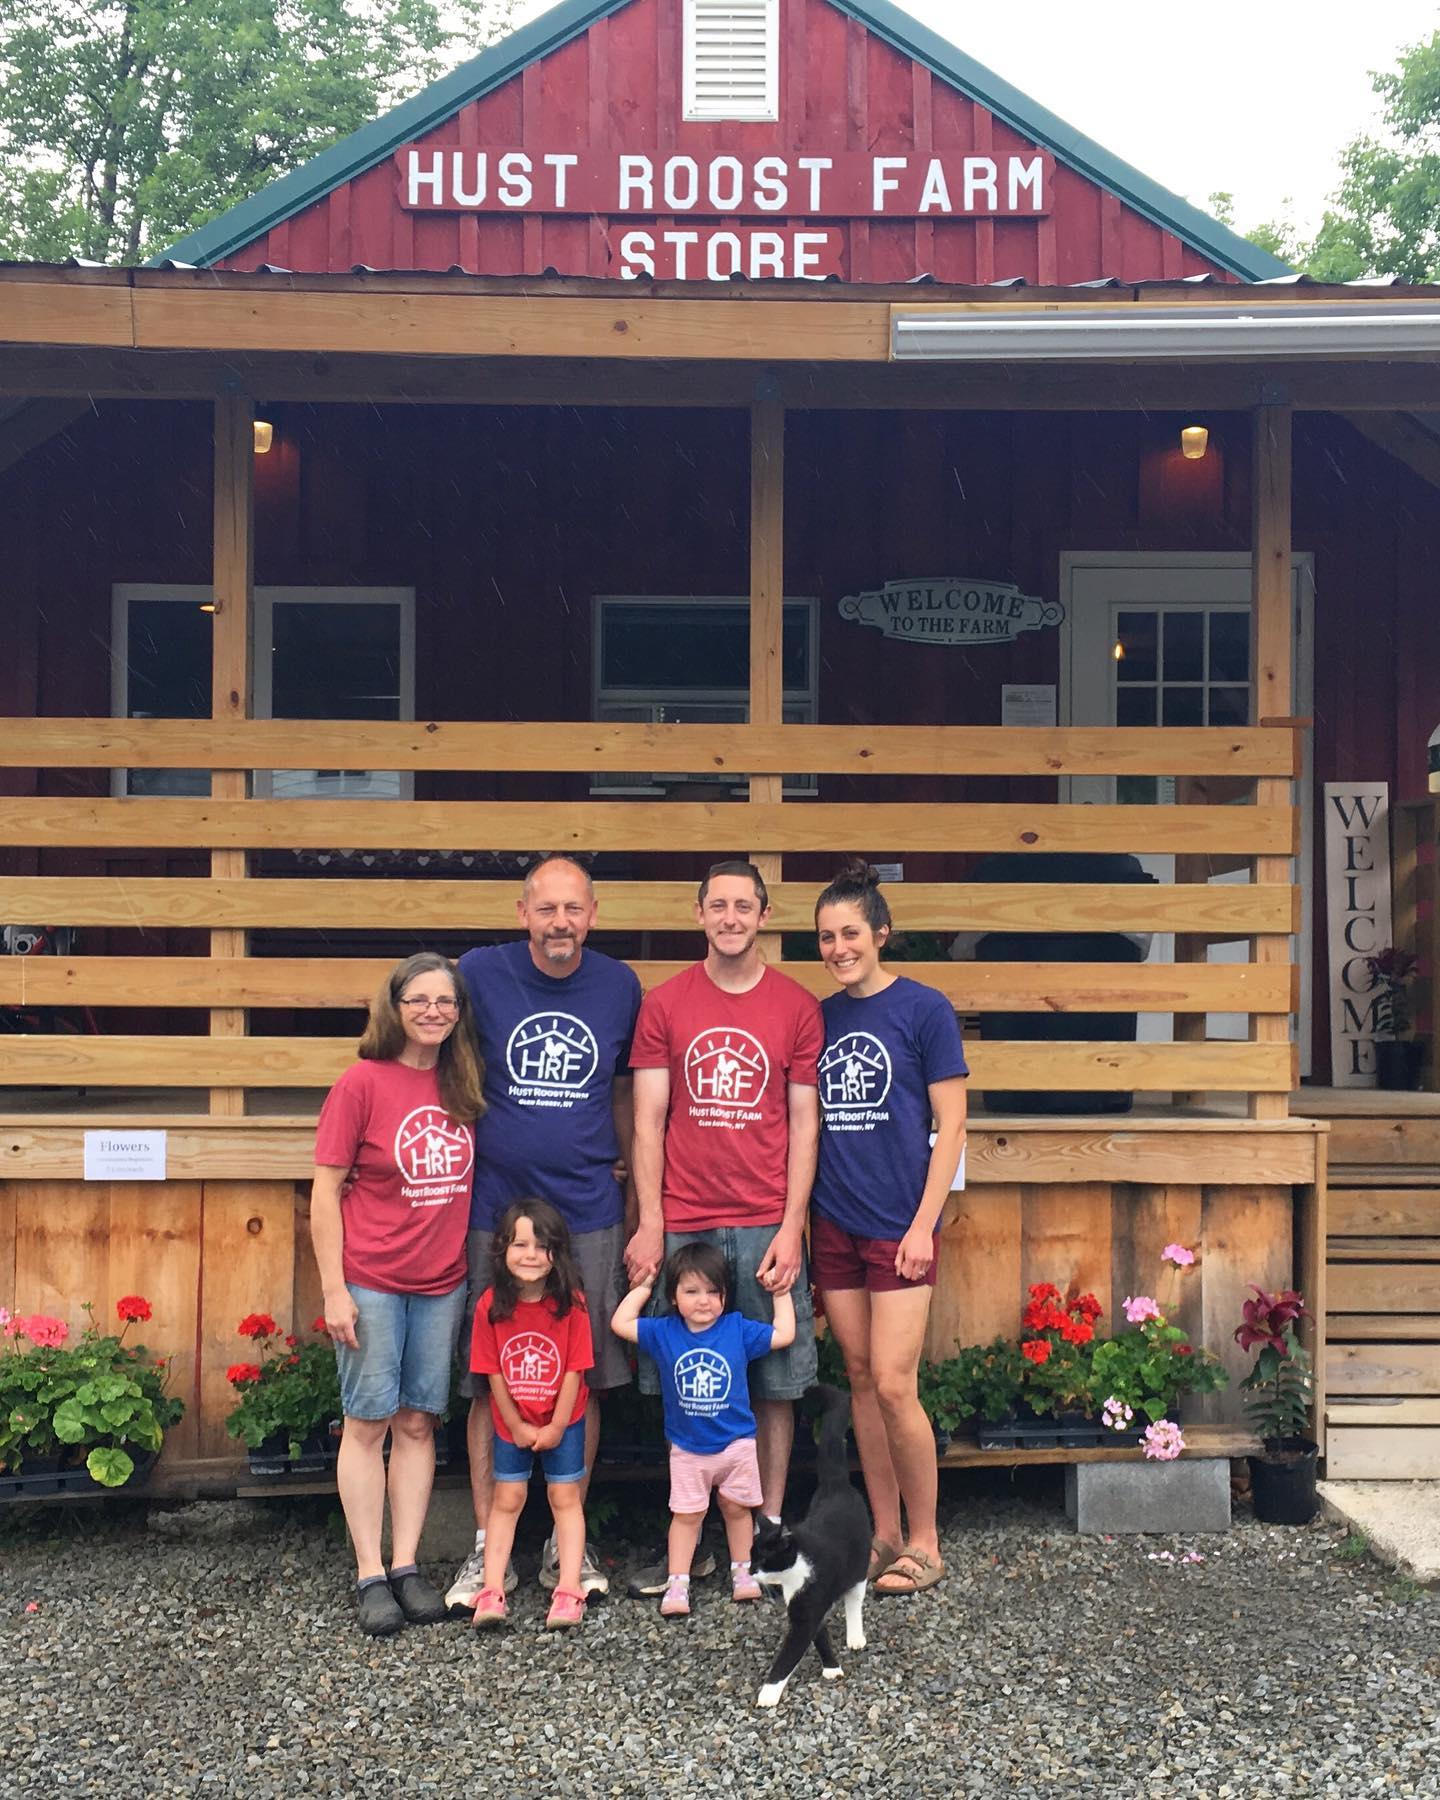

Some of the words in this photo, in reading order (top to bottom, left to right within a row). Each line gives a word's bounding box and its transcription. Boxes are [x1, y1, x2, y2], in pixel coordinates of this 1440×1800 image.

[407, 151, 578, 208] HUST
[619, 154, 833, 212] ROOST
[873, 156, 1044, 212] FARM
[620, 230, 828, 282] STORE
[879, 588, 1025, 620] WELCOME
[890, 616, 914, 632] TO
[918, 617, 955, 633] THE
[959, 618, 1011, 635] FARM
[1331, 795, 1385, 1076] WELCOME
[521, 1049, 583, 1080] HRF
[697, 1067, 754, 1099] HRF
[826, 1071, 875, 1101] HRF
[100, 1140, 151, 1152] Flowers
[411, 1145, 462, 1176] HRF
[509, 1360, 550, 1380] HRF
[682, 1376, 722, 1397] HRF
